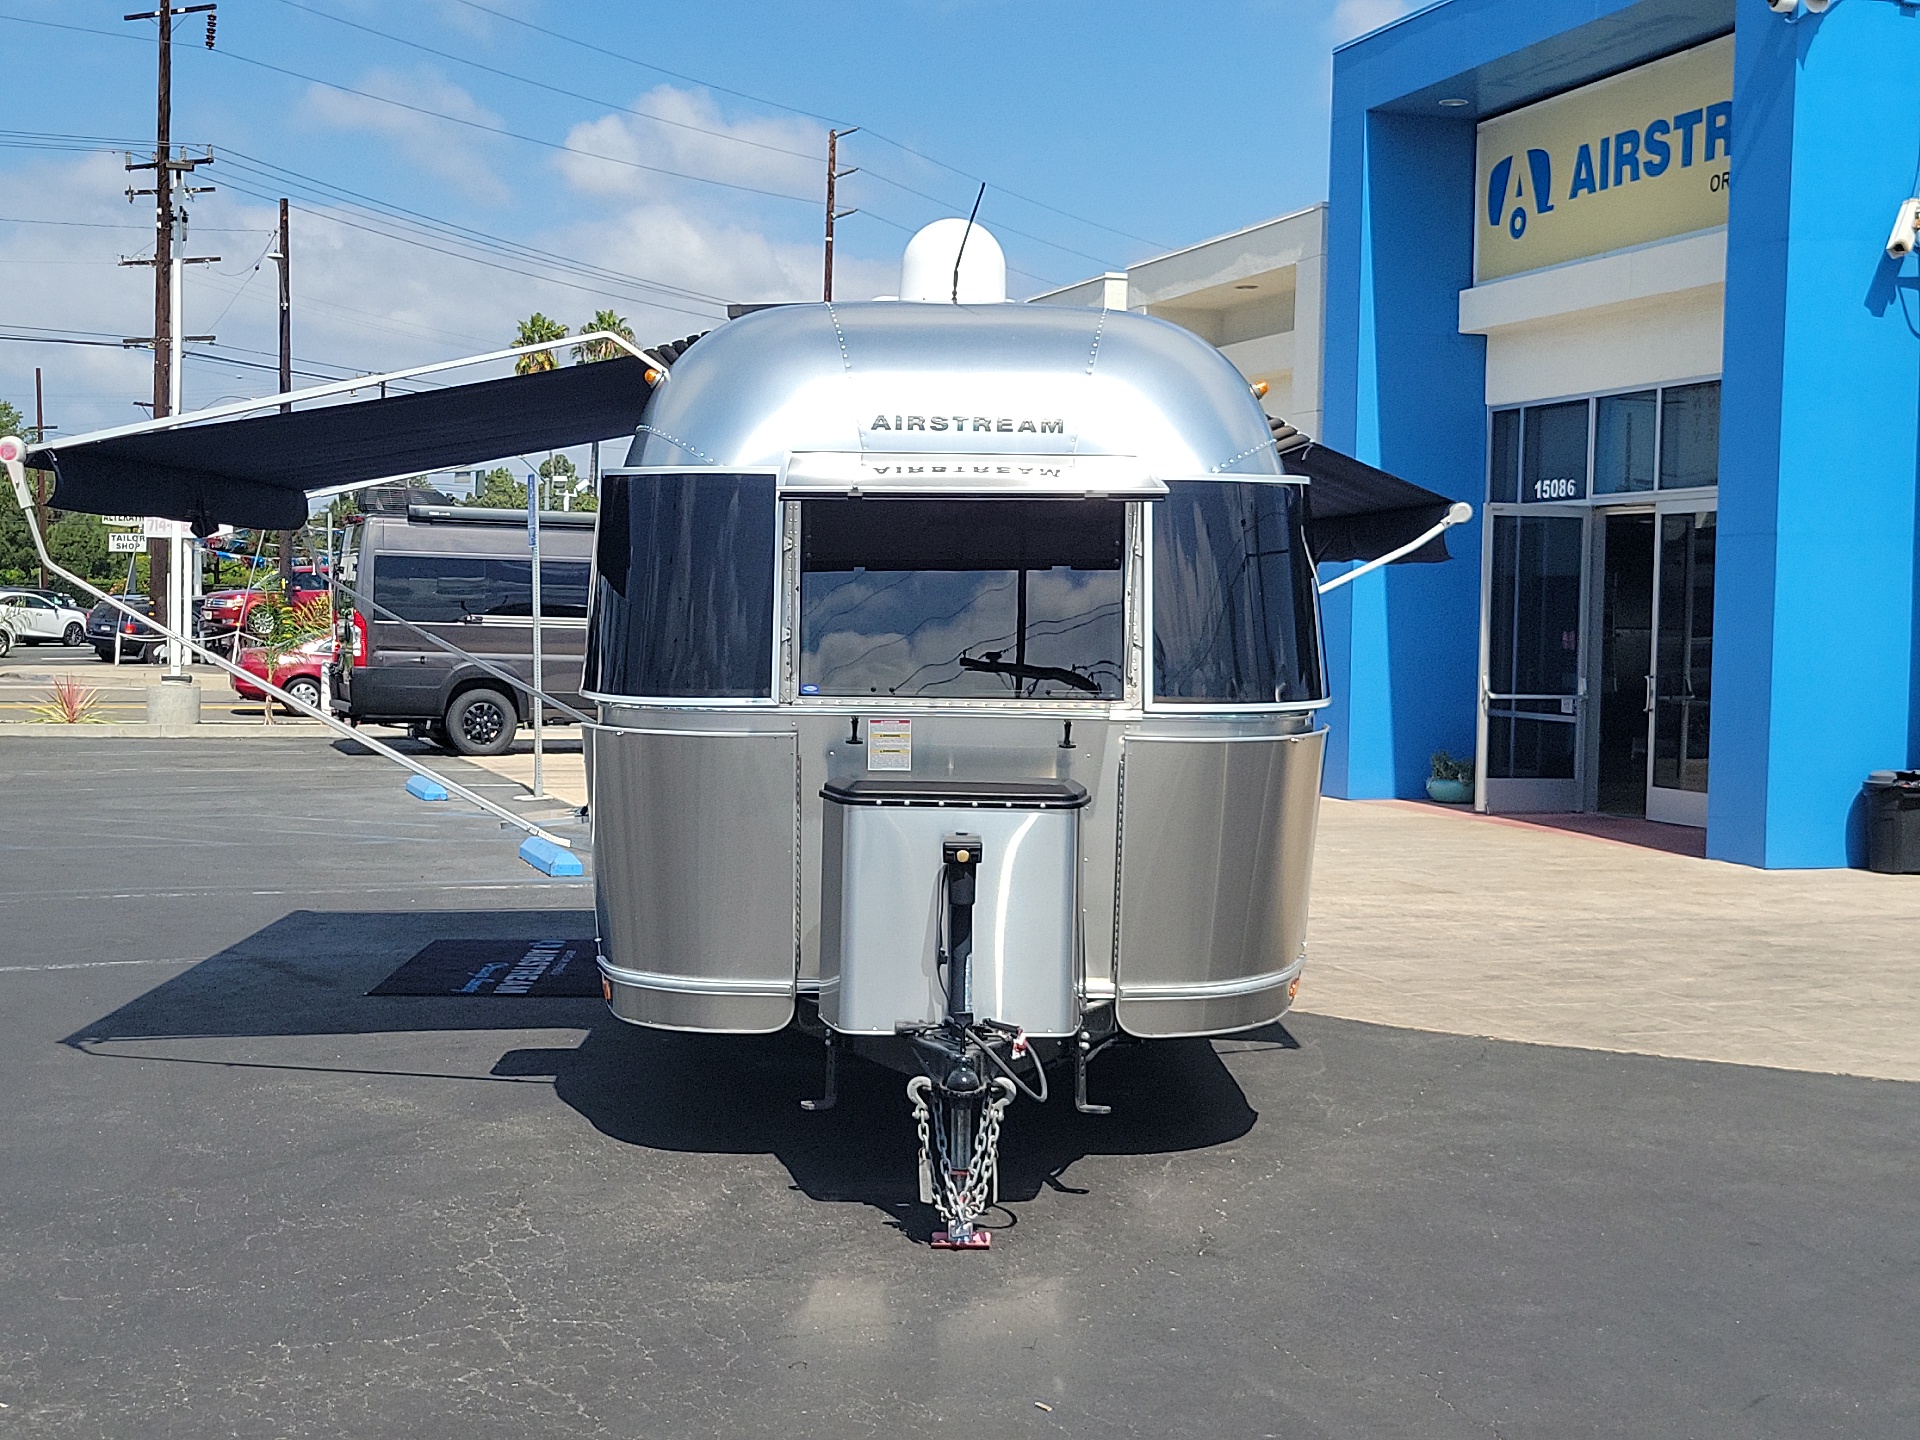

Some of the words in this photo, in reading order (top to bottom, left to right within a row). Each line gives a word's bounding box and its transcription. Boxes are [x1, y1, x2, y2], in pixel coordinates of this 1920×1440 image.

[1568, 101, 1733, 200] AIRSTR
[1710, 171, 1730, 192] OR
[871, 415, 1064, 434] AIRSTREAM
[1534, 478, 1577, 499] 15086
[111, 534, 146, 542] TAILOR
